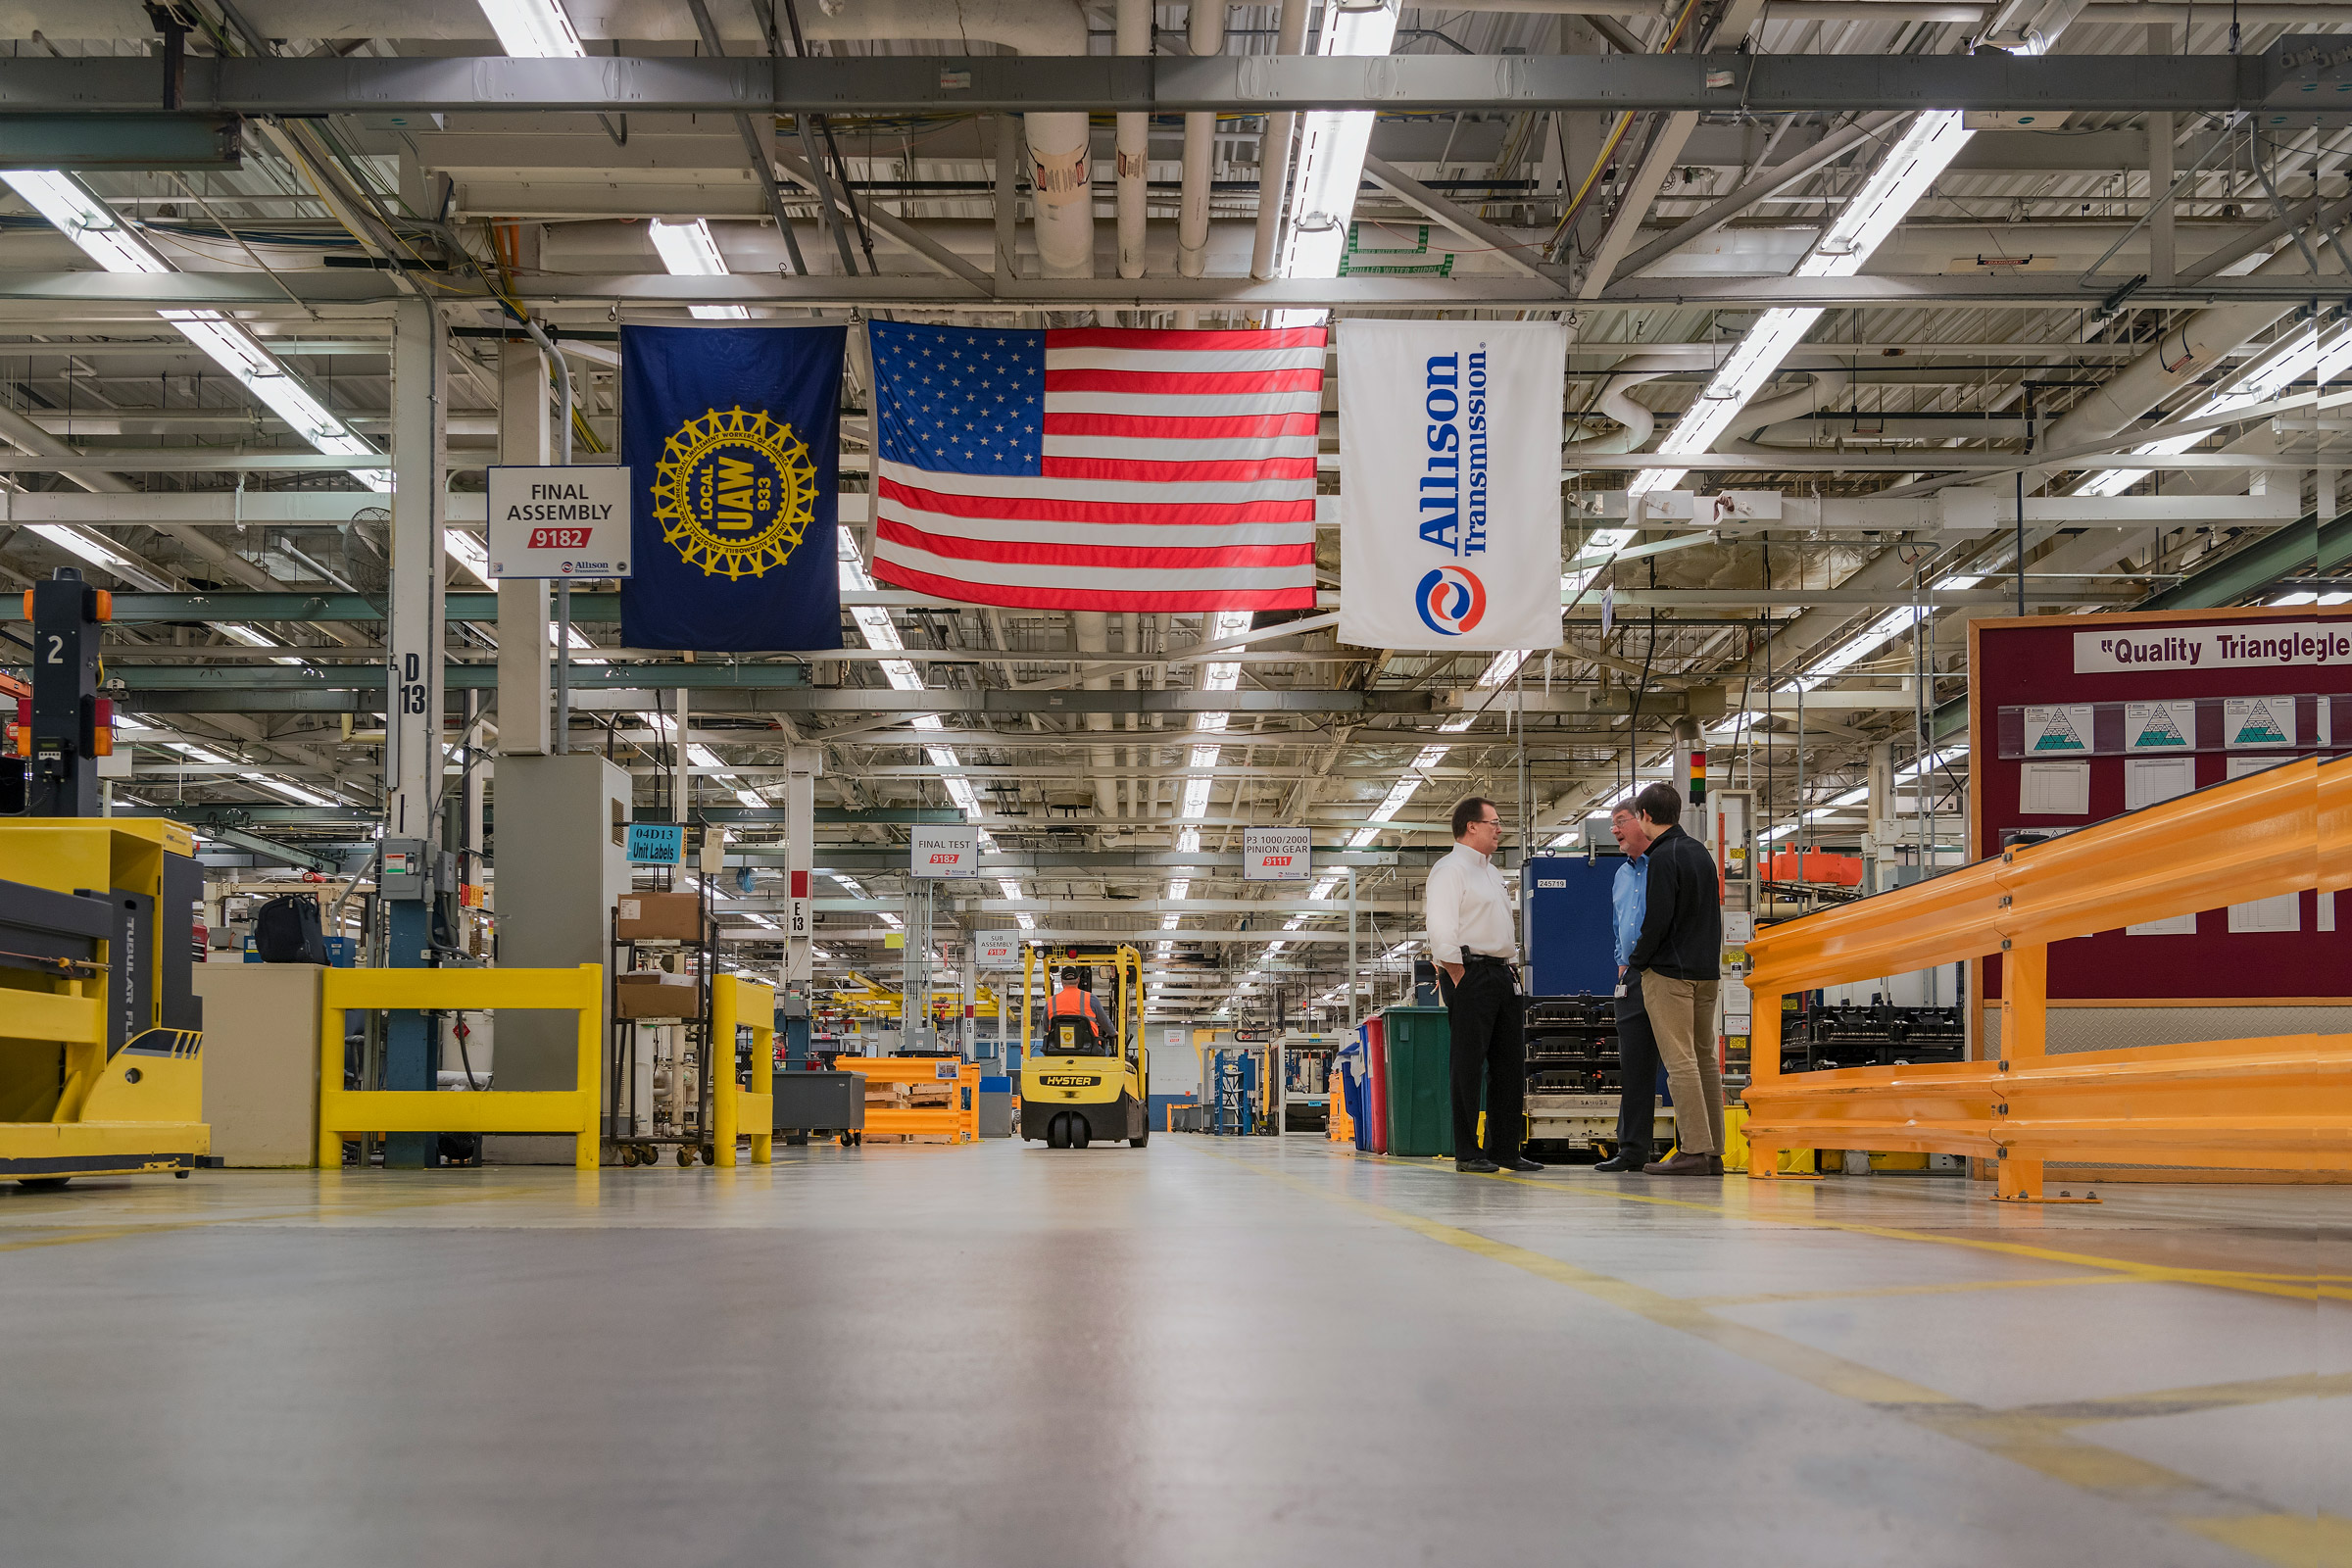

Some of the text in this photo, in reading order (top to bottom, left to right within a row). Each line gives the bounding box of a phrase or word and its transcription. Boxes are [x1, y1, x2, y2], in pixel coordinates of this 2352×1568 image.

[1412, 265, 1444, 273] SUPPLY
[687, 434, 720, 458] IMPLEMENT
[767, 443, 789, 467] AMERICA
[1419, 351, 1459, 557] Allison
[1464, 350, 1487, 557] Transmission
[531, 484, 589, 500] FINAL
[676, 459, 689, 509] AGRICULTURAL
[700, 465, 713, 520] LOCAL
[717, 456, 754, 530] UAW
[758, 477, 771, 512] 933
[507, 504, 612, 520] ASSEMBLY
[679, 511, 689, 525] AND
[535, 530, 582, 547] 9182
[688, 526, 721, 551] AEROSPACE
[769, 521, 788, 542] UNITED
[47, 635, 64, 664] 2
[405, 653, 419, 682] D
[401, 684, 425, 714] 13
[635, 828, 673, 841] 04D13
[918, 840, 970, 849] FINAL TEST
[633, 842, 674, 860] Unit Labels
[933, 855, 956, 863] 9182
[1247, 845, 1308, 854] PINION GEAR
[794, 902, 801, 916] E
[792, 916, 804, 931] 13
[125, 915, 135, 1004] TUBULAR
[1047, 1076, 1092, 1086] HYSTER
